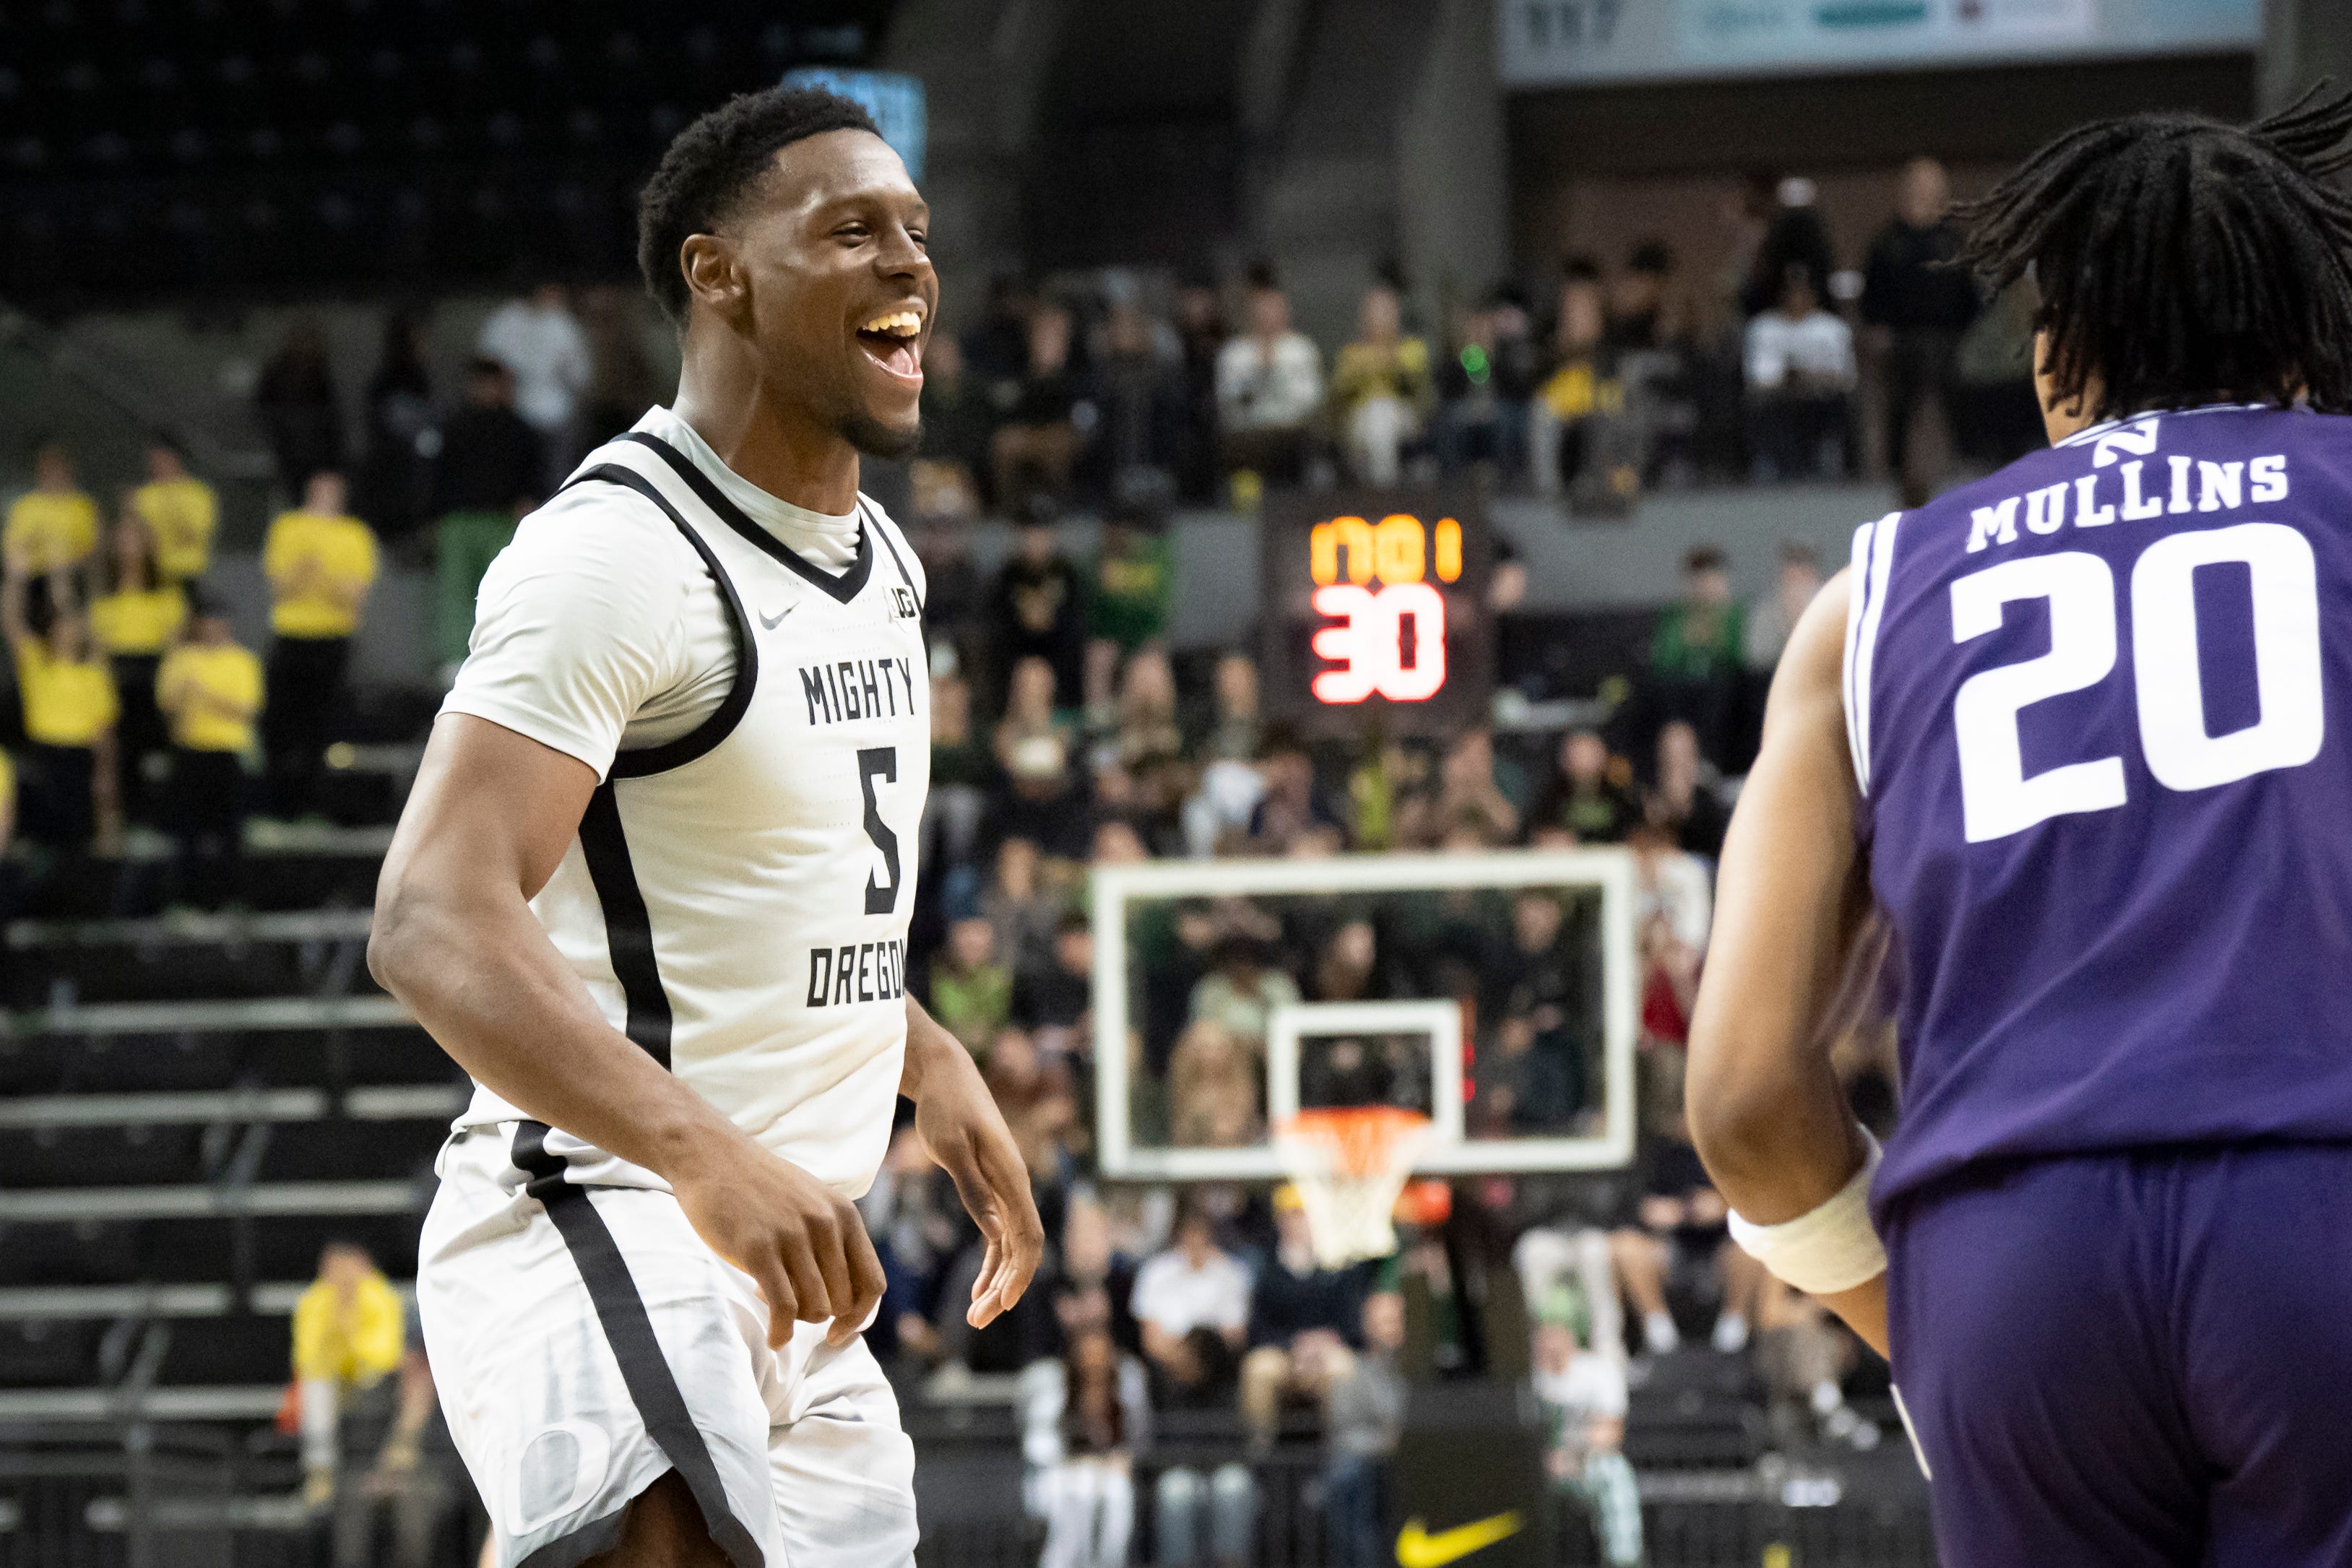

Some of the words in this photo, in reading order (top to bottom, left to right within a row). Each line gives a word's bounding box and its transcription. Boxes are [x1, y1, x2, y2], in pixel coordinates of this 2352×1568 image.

[1966, 454, 2288, 554] MULLINS
[798, 657, 915, 726] MIGHTY
[1310, 581, 1447, 704] 30
[1950, 521, 2325, 844] 20
[857, 746, 901, 916] 5
